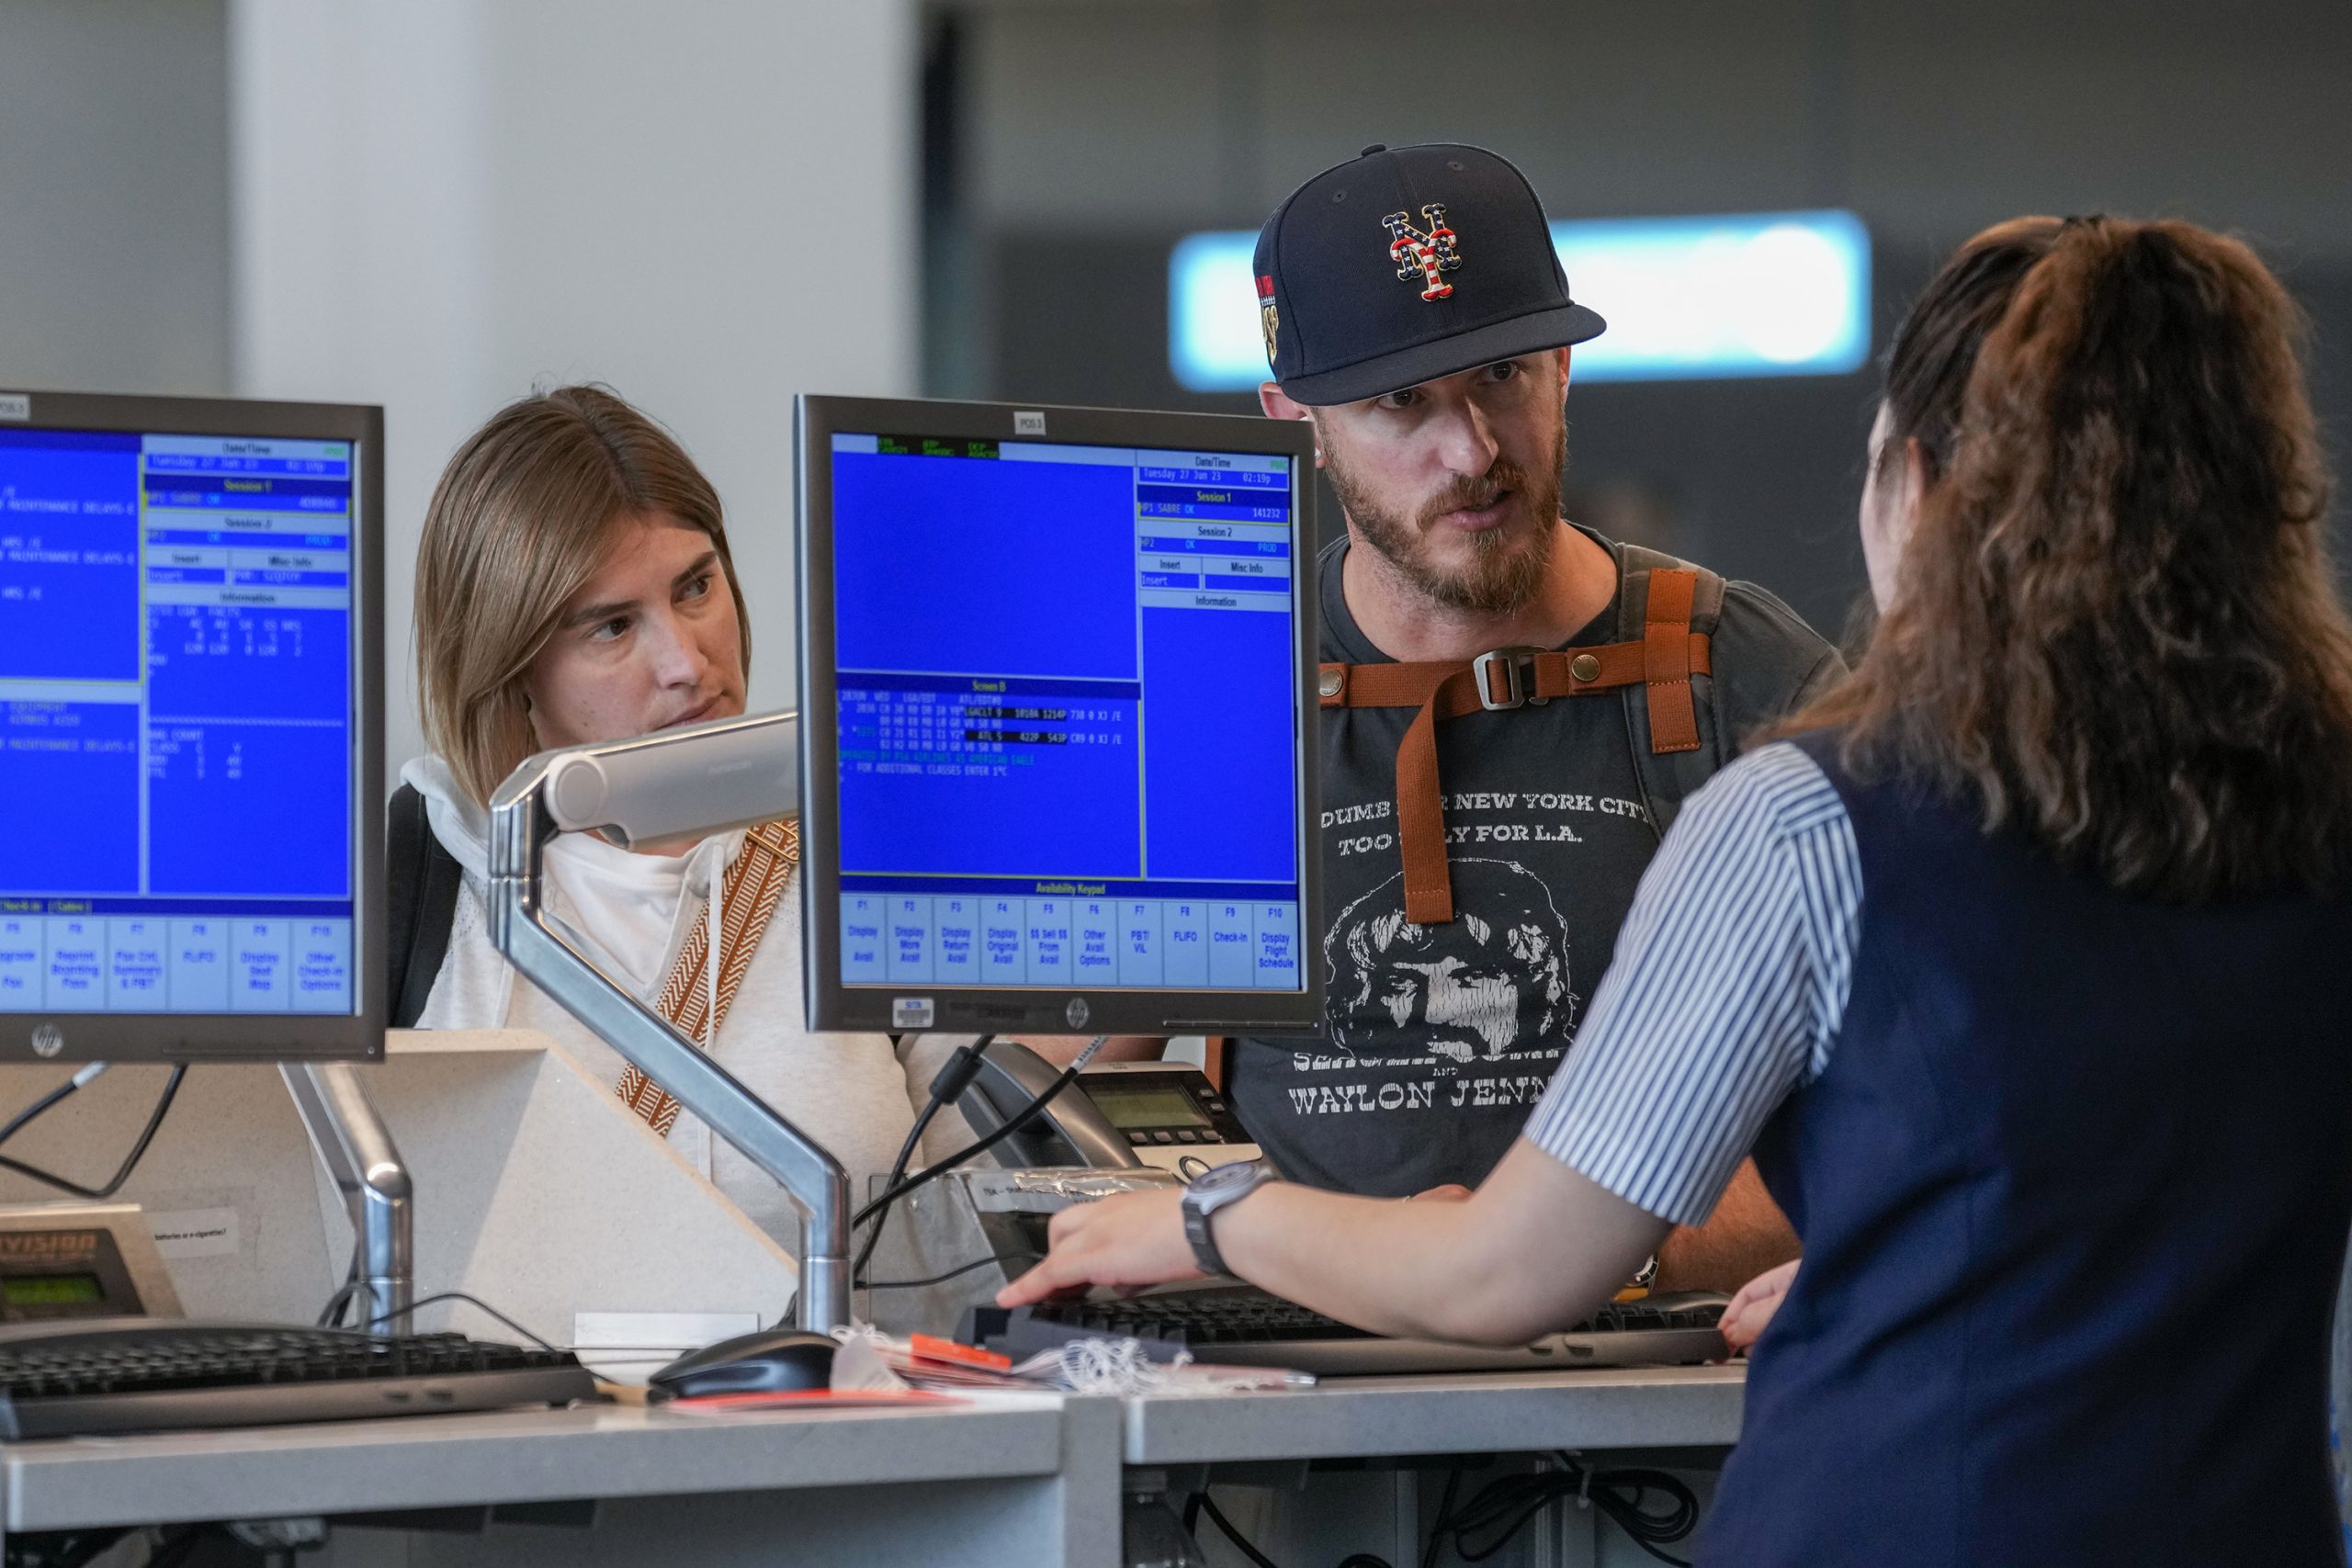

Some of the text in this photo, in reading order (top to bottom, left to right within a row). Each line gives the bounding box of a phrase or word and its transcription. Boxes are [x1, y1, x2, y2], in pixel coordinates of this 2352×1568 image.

[1195, 456, 1231, 468] Date/Time
[1143, 468, 1176, 481] Tuesday
[1180, 469, 1190, 479] 27
[1193, 470, 1208, 480] Jun
[1212, 471, 1222, 480] 23
[1196, 491, 1226, 502] Session
[1198, 526, 1226, 537] Session
[1258, 543, 1276, 553] PROD
[1160, 558, 1181, 570] Insert
[1231, 562, 1263, 574] Misc Info
[1142, 575, 1169, 586] Insert
[1195, 596, 1237, 607] Information
[926, 764, 962, 775] CLASSES
[1321, 801, 1391, 828] DUMB
[1454, 793, 1517, 811] NEW
[1522, 794, 1594, 812] YORK
[1339, 834, 1393, 856] TOO
[1476, 825, 1529, 842] FOR
[1535, 824, 1583, 842] L.A.
[1036, 882, 1106, 897] Availability Keypad
[857, 900, 868, 910] F1
[904, 901, 915, 912] F2
[951, 902, 962, 912] F3
[997, 903, 1008, 913] F4
[1044, 904, 1054, 914] F5
[1090, 905, 1099, 915] F6
[1136, 906, 1145, 916] F7
[1181, 907, 1190, 917] F8
[1226, 907, 1235, 917] F9
[1269, 908, 1283, 919] F10
[848, 926, 878, 939] Display
[895, 927, 924, 940] Display
[942, 927, 971, 940] Display
[988, 928, 1017, 941] Display
[1084, 931, 1106, 941] Other
[1174, 931, 1197, 942] FLIFO
[899, 940, 921, 950] More
[1261, 933, 1290, 946] Display
[944, 941, 971, 951] Return
[988, 941, 1019, 953] Original
[1039, 942, 1059, 953] From
[1085, 942, 1104, 953] Avail
[854, 952, 874, 963] Avail
[1265, 946, 1288, 958] Flight
[900, 953, 921, 963] Avail
[947, 953, 967, 964] Avail
[993, 953, 1013, 964] Avail
[1040, 954, 1059, 965] Avail
[1080, 955, 1111, 967] Options
[1260, 958, 1295, 969] Schedule
[1288, 1081, 1435, 1115] WAYLON
[0, 1233, 97, 1252] VISION
